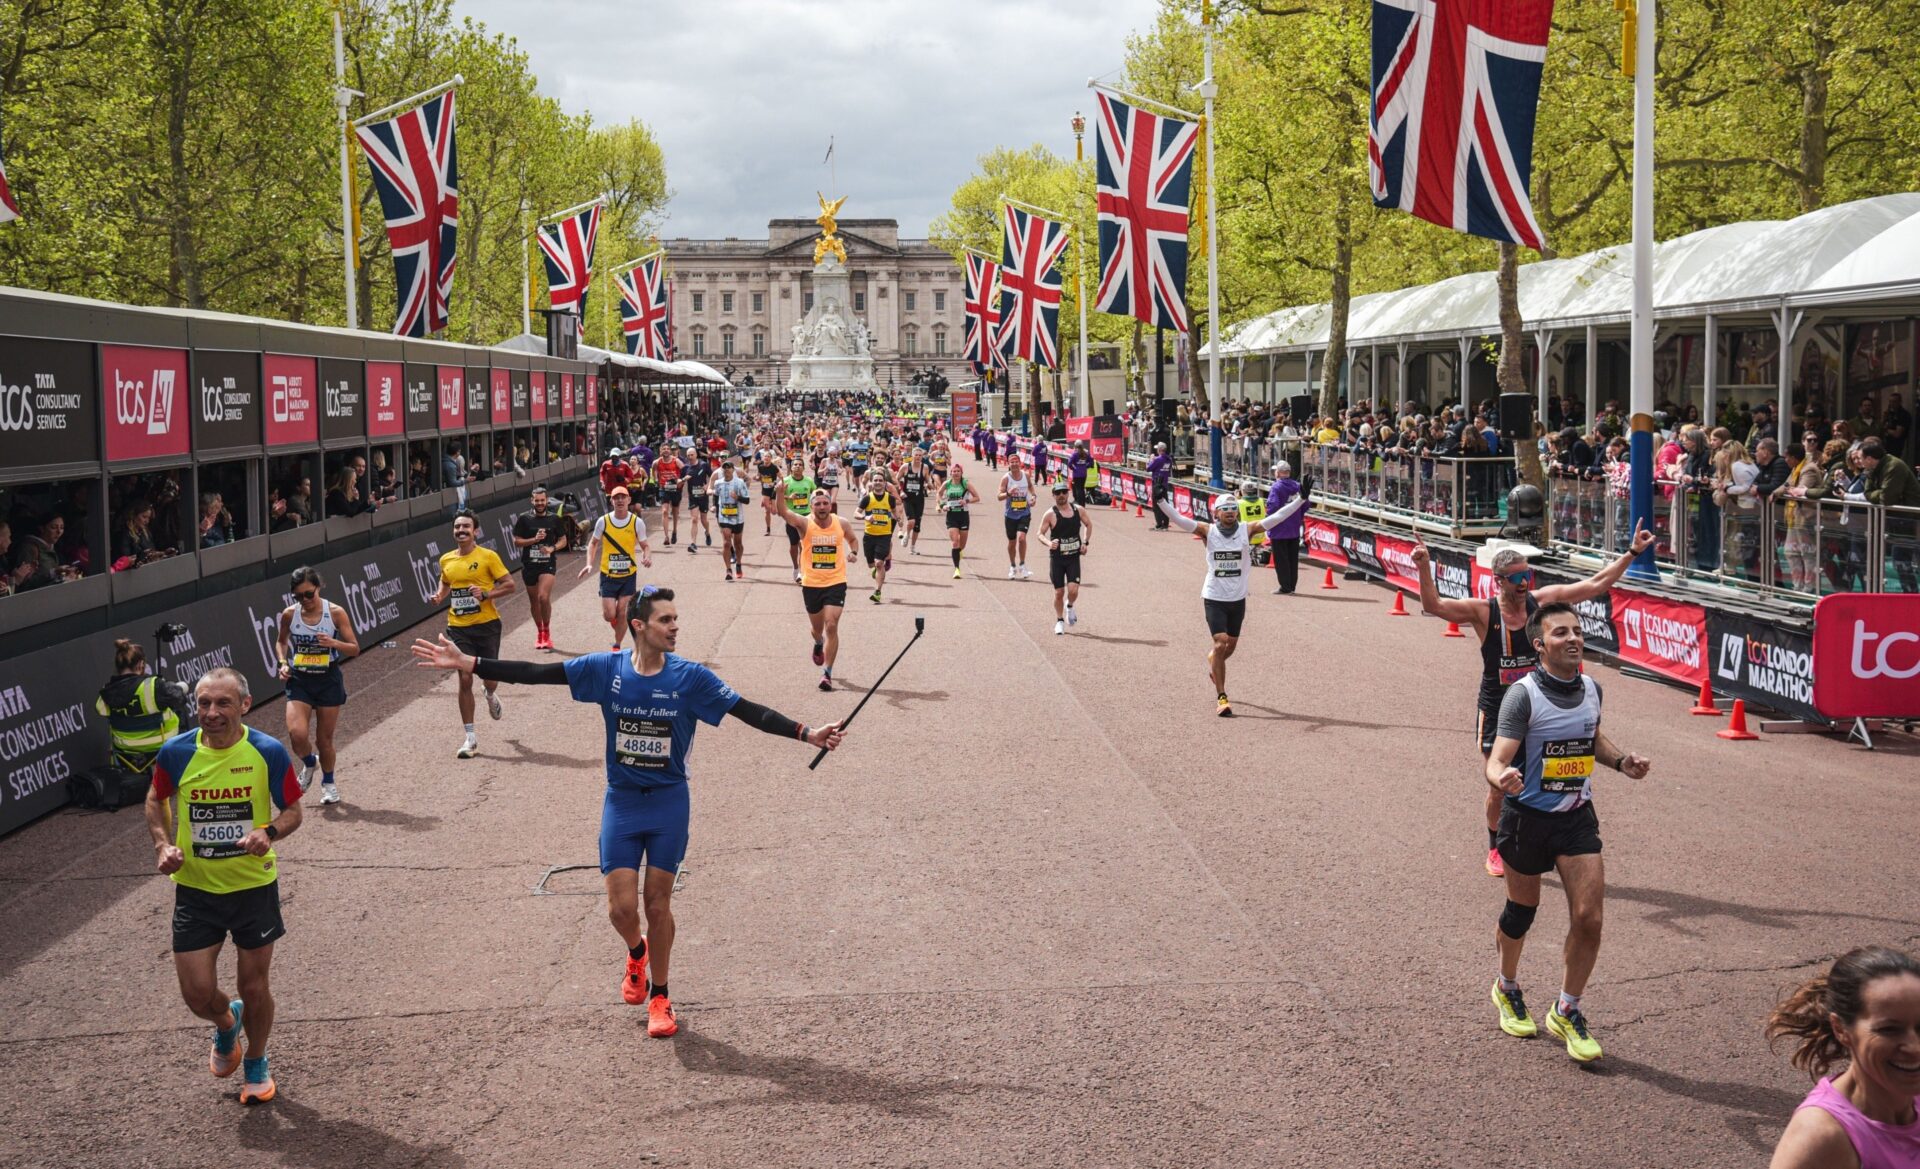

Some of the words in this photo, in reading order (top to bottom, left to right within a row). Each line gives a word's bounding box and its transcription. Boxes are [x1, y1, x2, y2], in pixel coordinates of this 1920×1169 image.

[35, 373, 56, 389] TATA
[223, 377, 236, 389] TATA
[289, 377, 302, 387] ABBOTT
[115, 368, 146, 425] tcs
[201, 376, 224, 422] tcs
[224, 393, 251, 405] CONSULTANCY
[289, 388, 302, 398] WORLD
[326, 381, 341, 417] tcs
[409, 382, 419, 413] tcs
[0, 372, 34, 431] tcs
[36, 394, 81, 409] CONSULTANCY
[289, 399, 310, 410] MARATHON
[37, 414, 67, 430] SERVICES
[224, 409, 243, 421] SERVICES
[290, 411, 305, 421] MAJORS
[364, 562, 381, 580] TATA
[370, 577, 403, 603] CONSULTANCY
[340, 574, 377, 635] tcs
[377, 601, 400, 624] SERVICES
[1573, 600, 1607, 622] ONDON
[1646, 633, 1700, 669] MARATHON
[1500, 657, 1517, 667] tcs
[0, 685, 31, 720] ATA
[623, 706, 632, 714] to
[633, 706, 648, 715] the
[648, 708, 678, 718] fullest
[0, 703, 87, 760] CONSULTANCY
[620, 719, 639, 733] tcs
[623, 738, 662, 754] 48848
[1546, 743, 1565, 756] tcs
[9, 750, 70, 800] SERVICES
[1556, 761, 1585, 776] 3083
[190, 786, 253, 800] STUART
[192, 806, 214, 820] tcs
[199, 825, 244, 840] 45603
